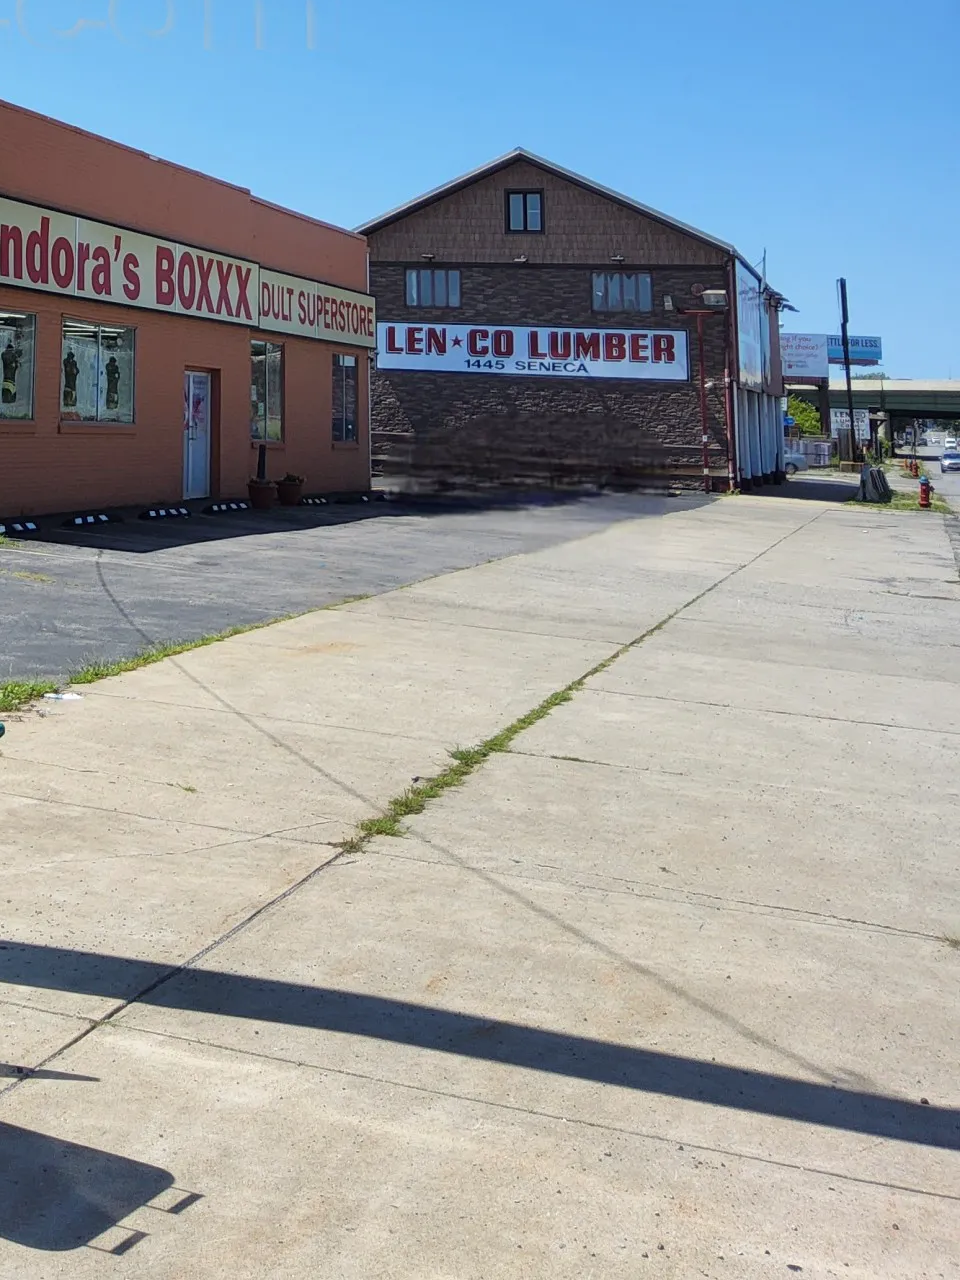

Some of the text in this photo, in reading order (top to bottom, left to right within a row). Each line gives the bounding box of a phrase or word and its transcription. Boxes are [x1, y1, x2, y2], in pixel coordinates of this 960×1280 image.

[155, 245, 253, 320] BOXXX
[259, 281, 374, 337] DULT SUPERSTORE
[464, 359, 589, 373] 1445 SENECA
[527, 330, 676, 364] LUMBER
